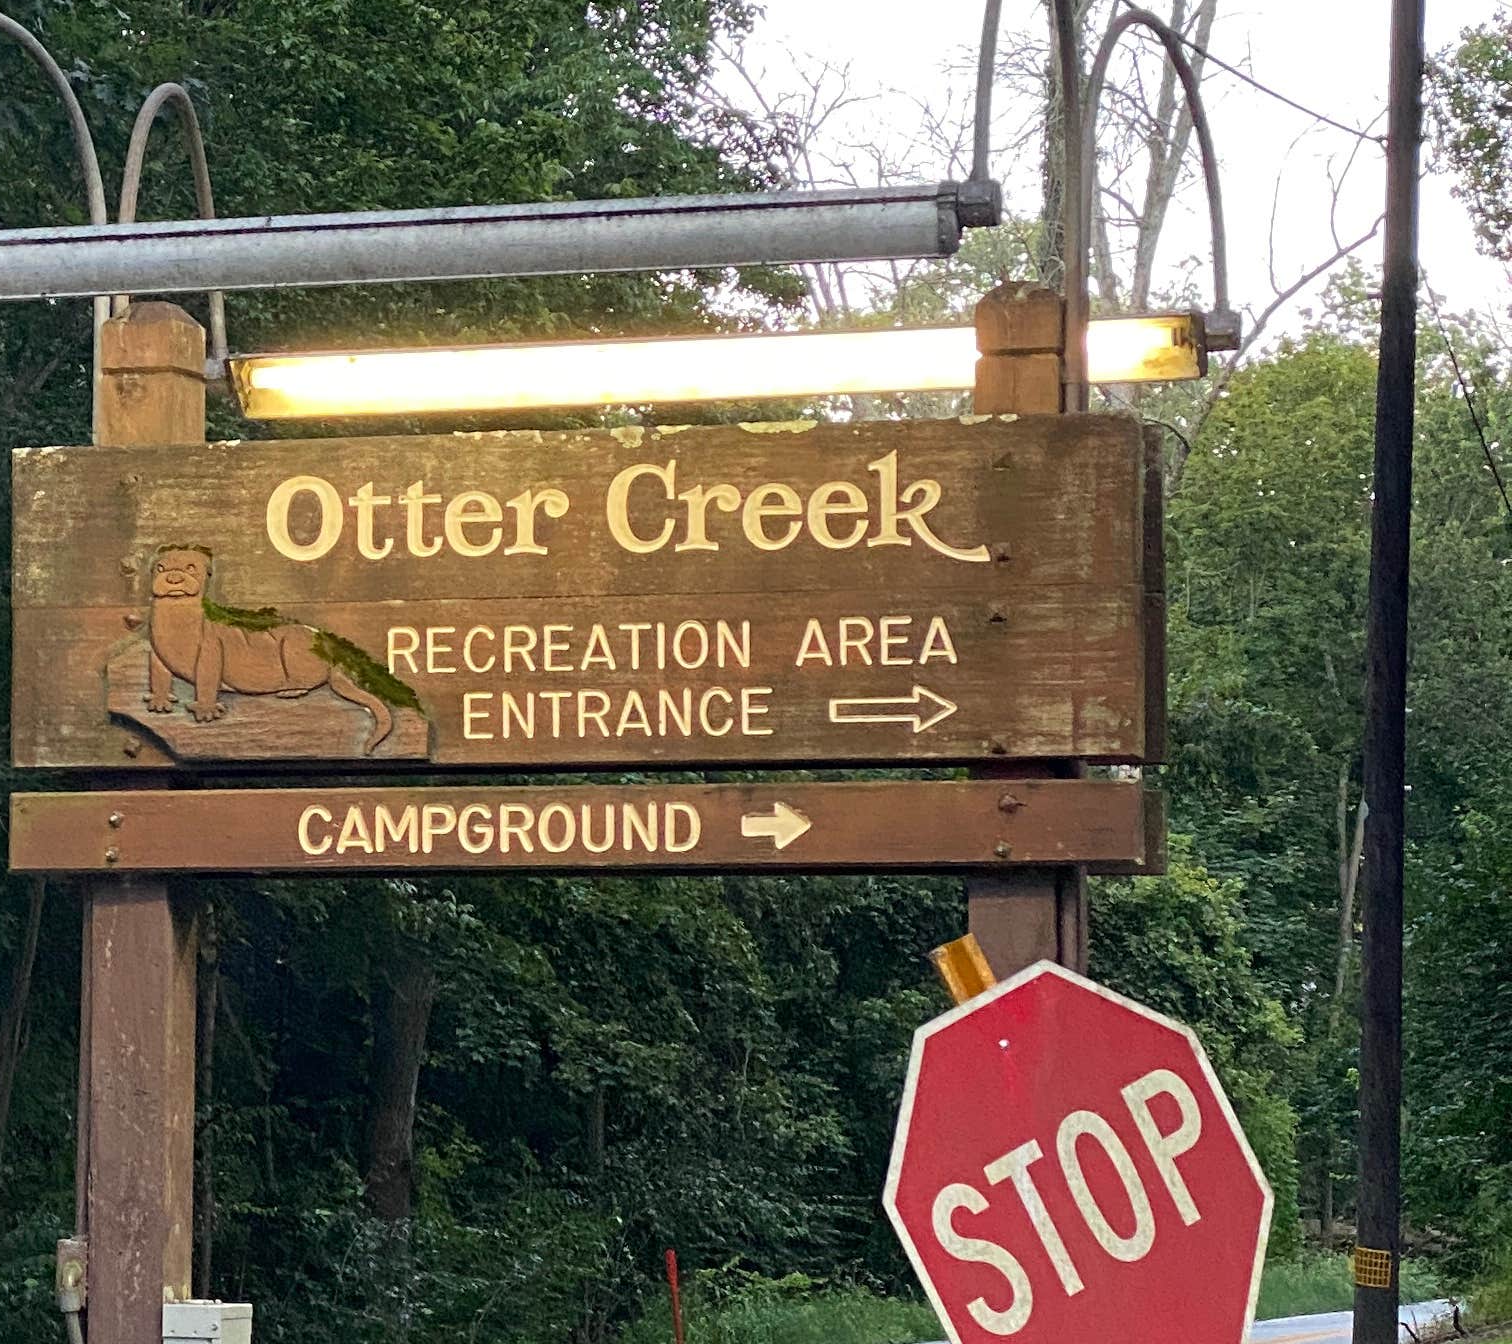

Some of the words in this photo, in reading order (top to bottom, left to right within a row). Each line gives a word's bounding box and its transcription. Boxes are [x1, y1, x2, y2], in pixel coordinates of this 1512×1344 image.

[266, 475, 569, 562] Otter
[606, 449, 992, 562] Creek
[386, 619, 753, 675] RECREATION
[796, 616, 959, 667] AREA
[463, 687, 774, 740] ENTRANCE
[297, 801, 703, 856] CAMPGROUND
[932, 1069, 1202, 1336] STOP
